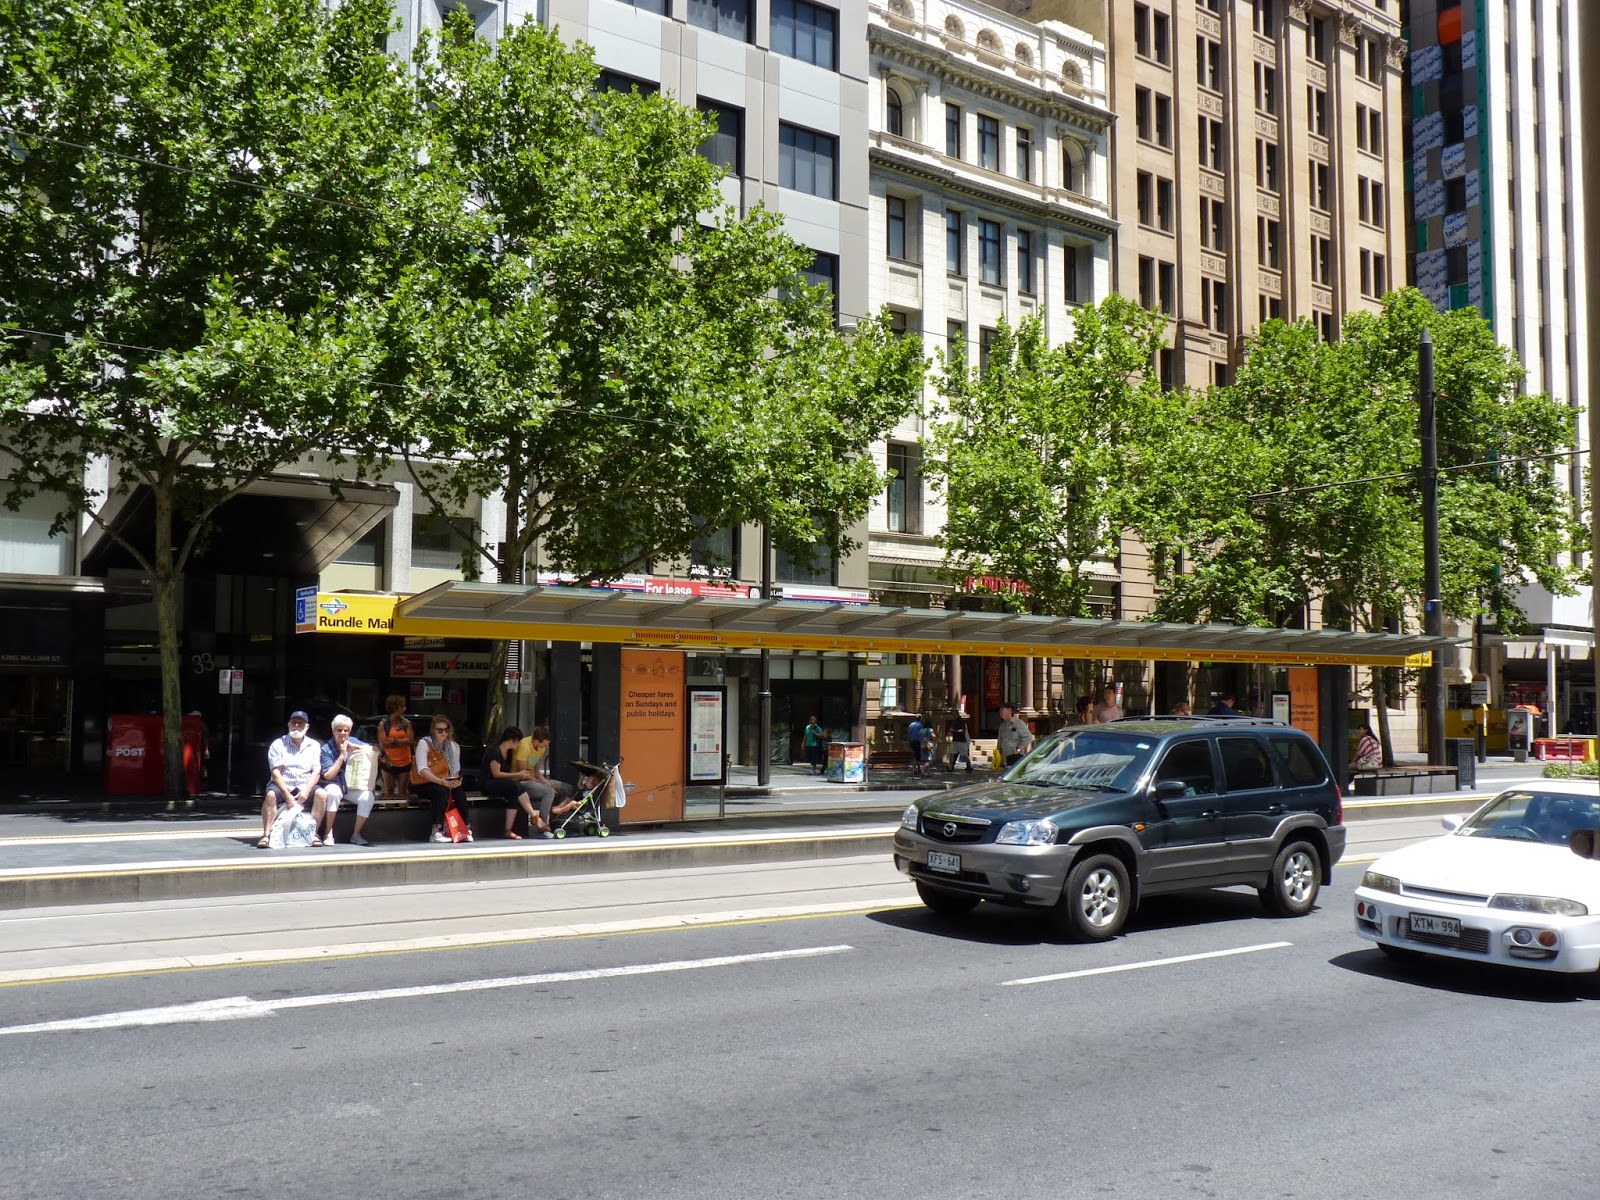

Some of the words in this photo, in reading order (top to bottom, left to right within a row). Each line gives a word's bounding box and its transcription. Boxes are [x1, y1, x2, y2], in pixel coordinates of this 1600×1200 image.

[646, 582, 663, 594] For
[666, 583, 692, 595] lease
[319, 616, 363, 628] Rundle
[368, 618, 394, 629] Mall
[192, 653, 214, 674] 33
[703, 659, 719, 675] 29
[628, 691, 656, 699] Cheaper
[635, 701, 663, 709] Sundays
[626, 710, 646, 718] public
[648, 710, 675, 718] holidays
[116, 748, 144, 756] POST
